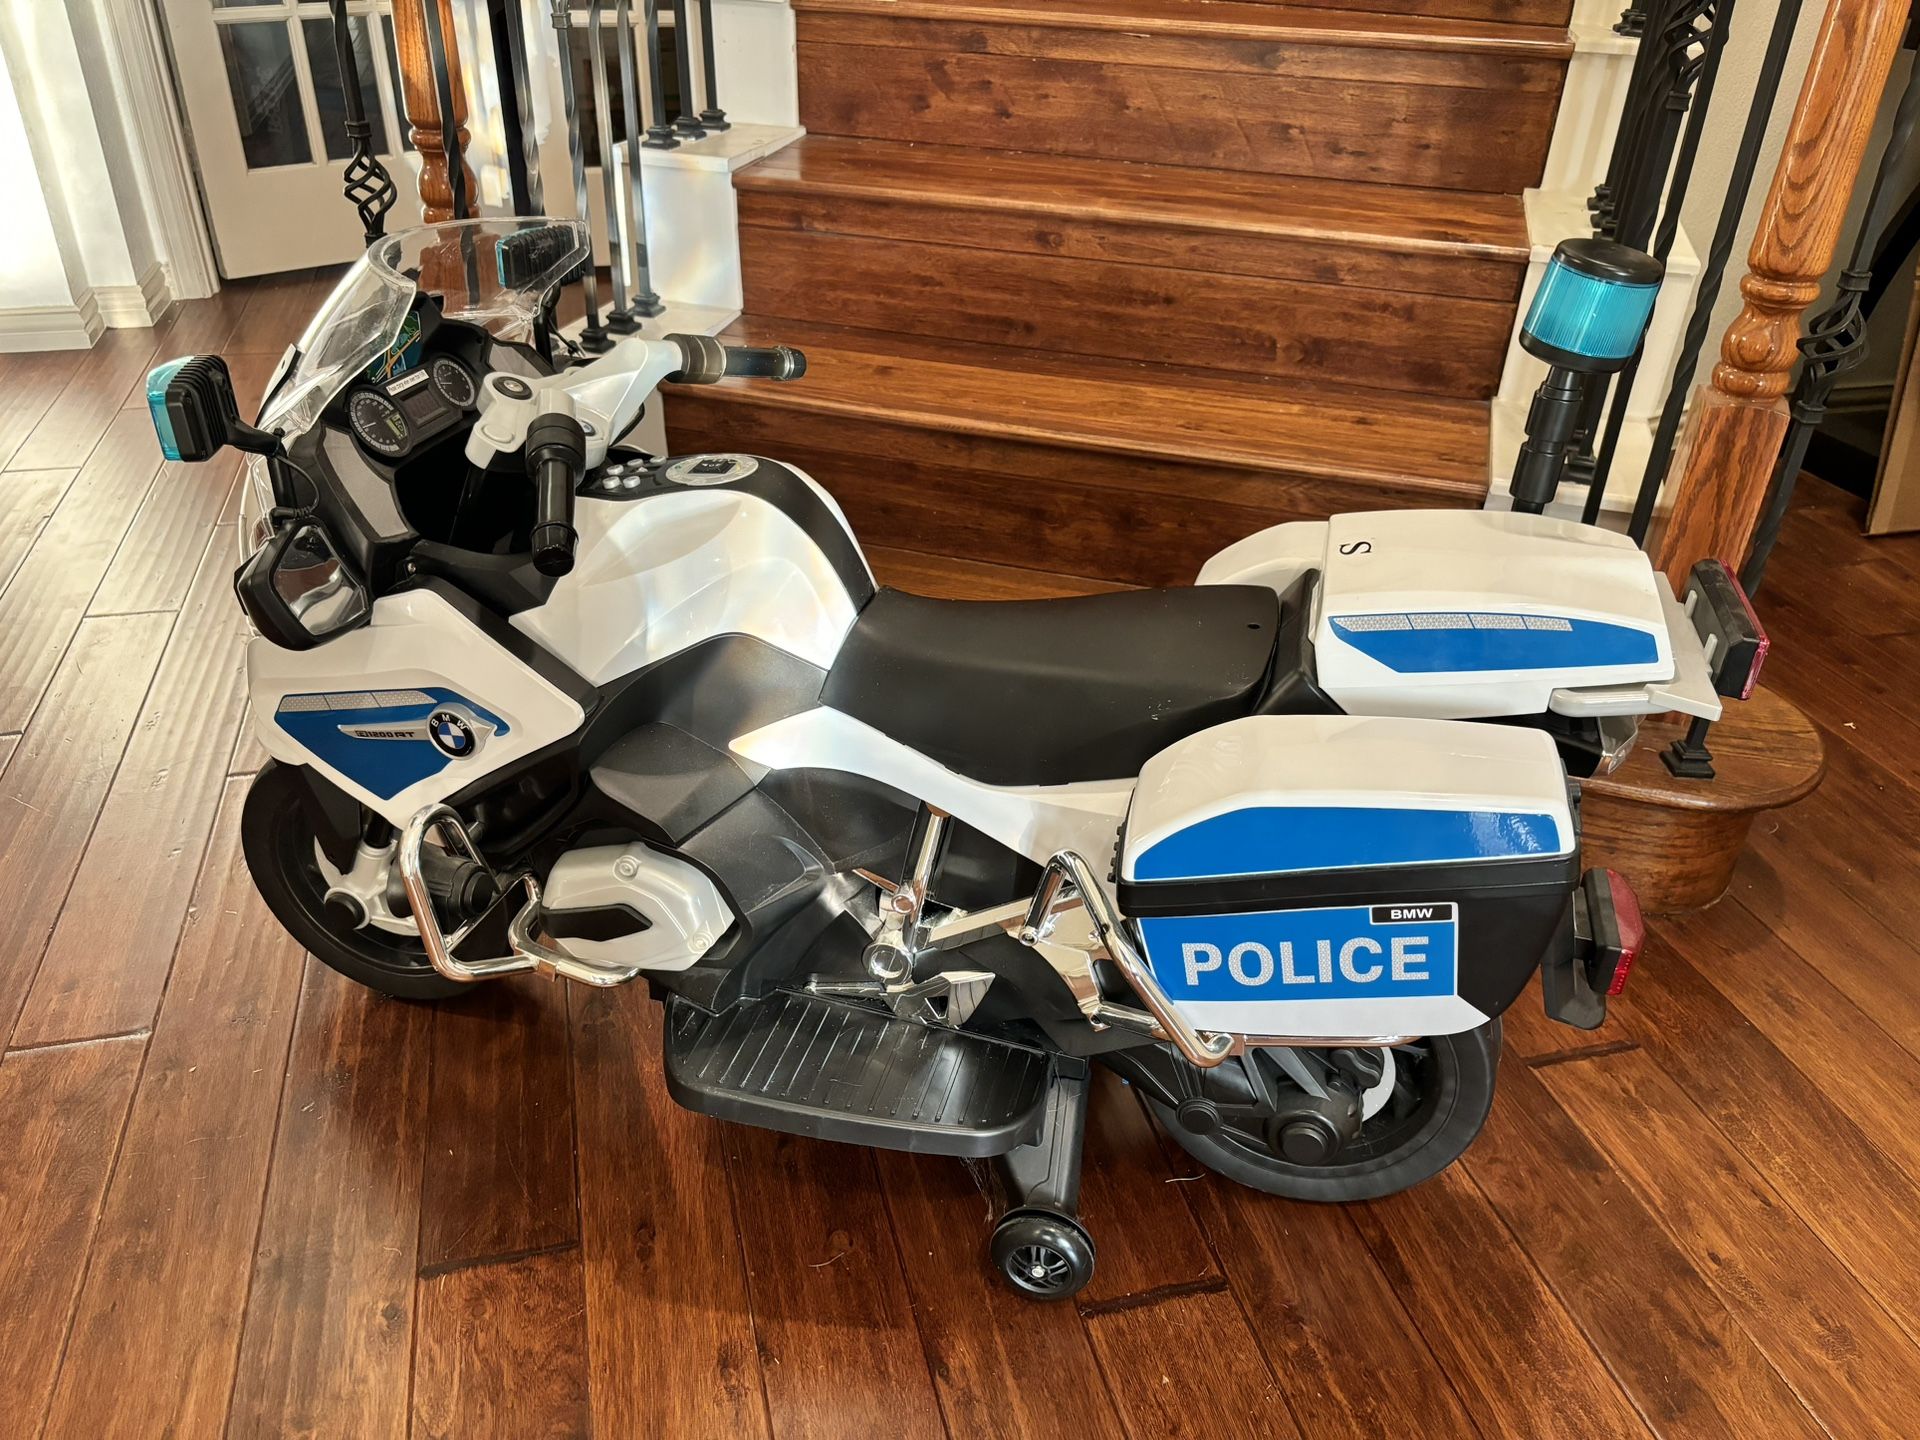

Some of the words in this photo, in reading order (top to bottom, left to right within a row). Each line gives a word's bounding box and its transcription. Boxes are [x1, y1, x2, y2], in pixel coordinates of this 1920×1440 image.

[1339, 541, 1372, 555] S
[430, 714, 470, 730] BMW
[1390, 908, 1433, 920] BMW
[1181, 936, 1430, 986] POLICE
